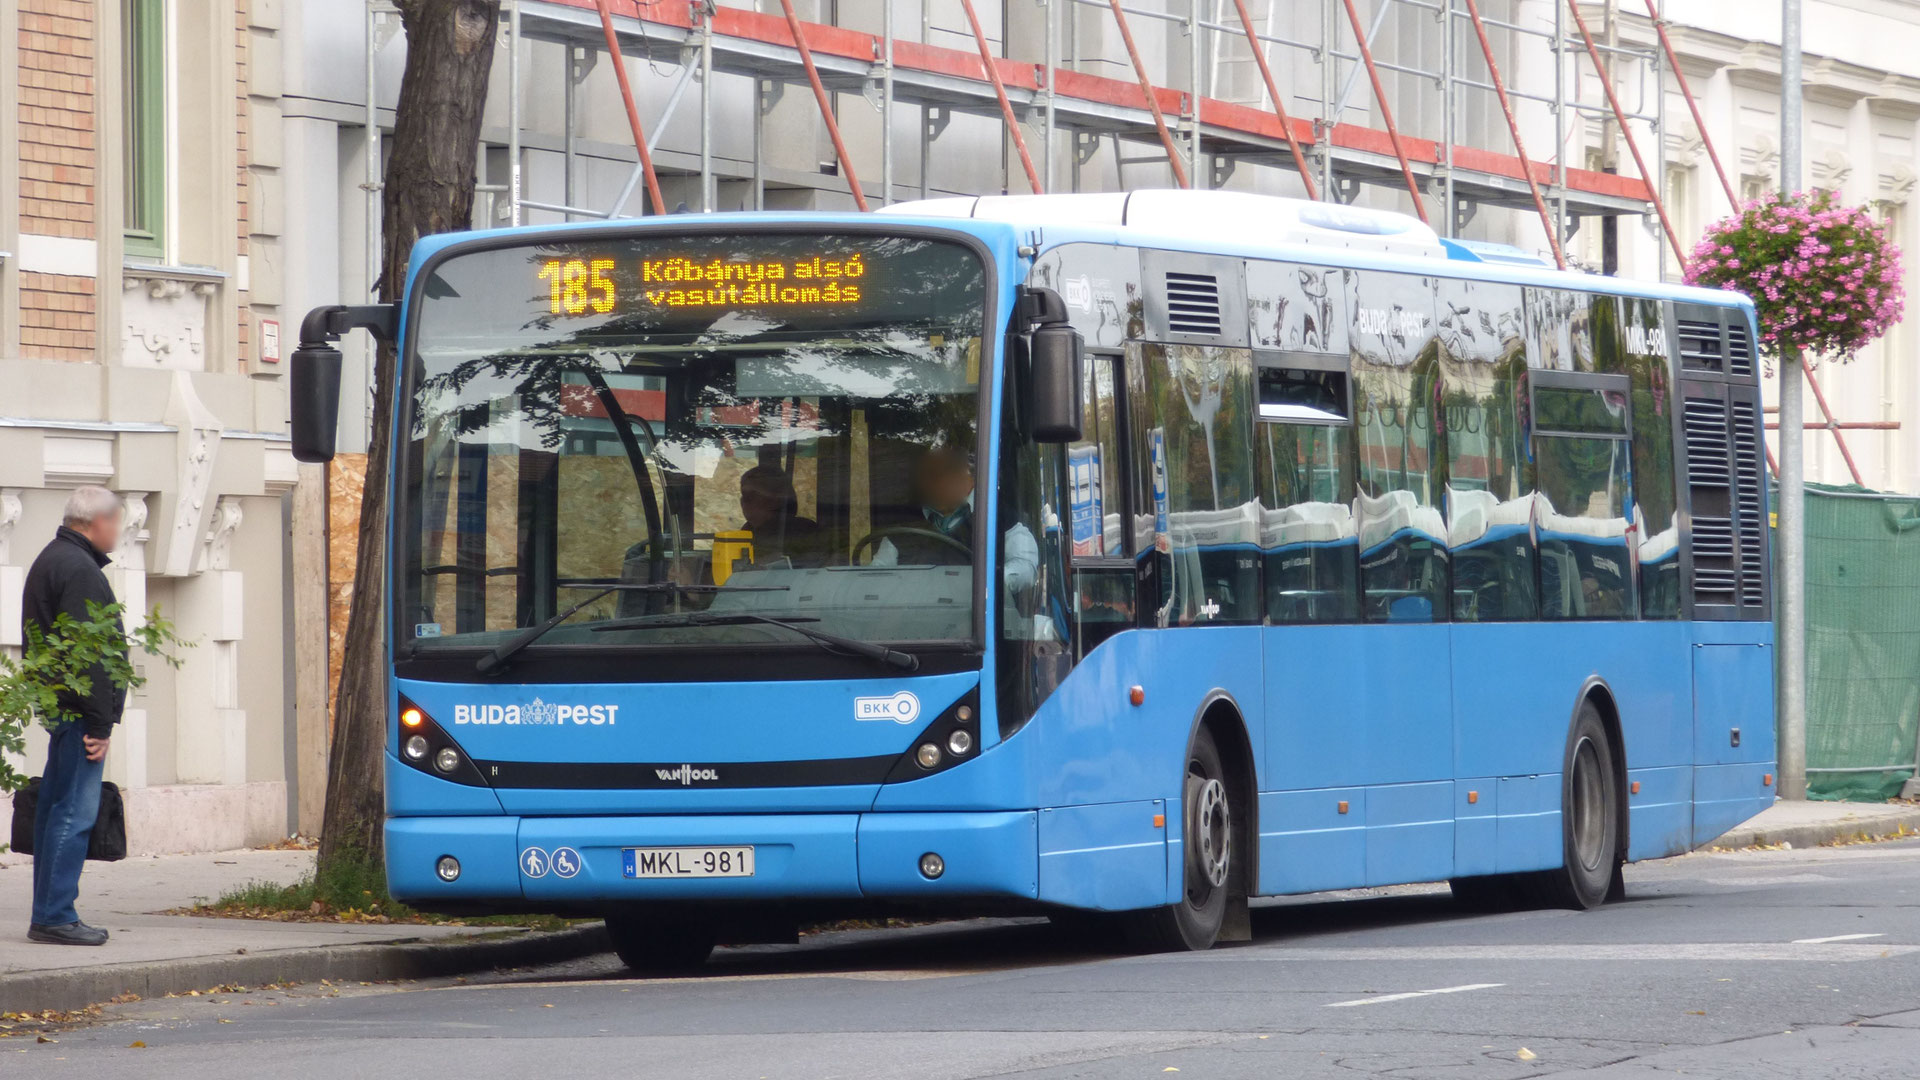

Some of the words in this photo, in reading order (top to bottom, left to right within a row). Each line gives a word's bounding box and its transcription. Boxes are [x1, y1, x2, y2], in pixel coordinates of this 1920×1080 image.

[642, 257, 785, 282] Kőbánya
[793, 253, 864, 279] alsó
[537, 259, 616, 314] 185
[645, 280, 861, 306] vasútállomás
[1625, 326, 1668, 357] MKL-981
[863, 703, 890, 714] BKK
[491, 765, 499, 776] H
[626, 865, 634, 874] H
[640, 850, 745, 874] MKL-981
